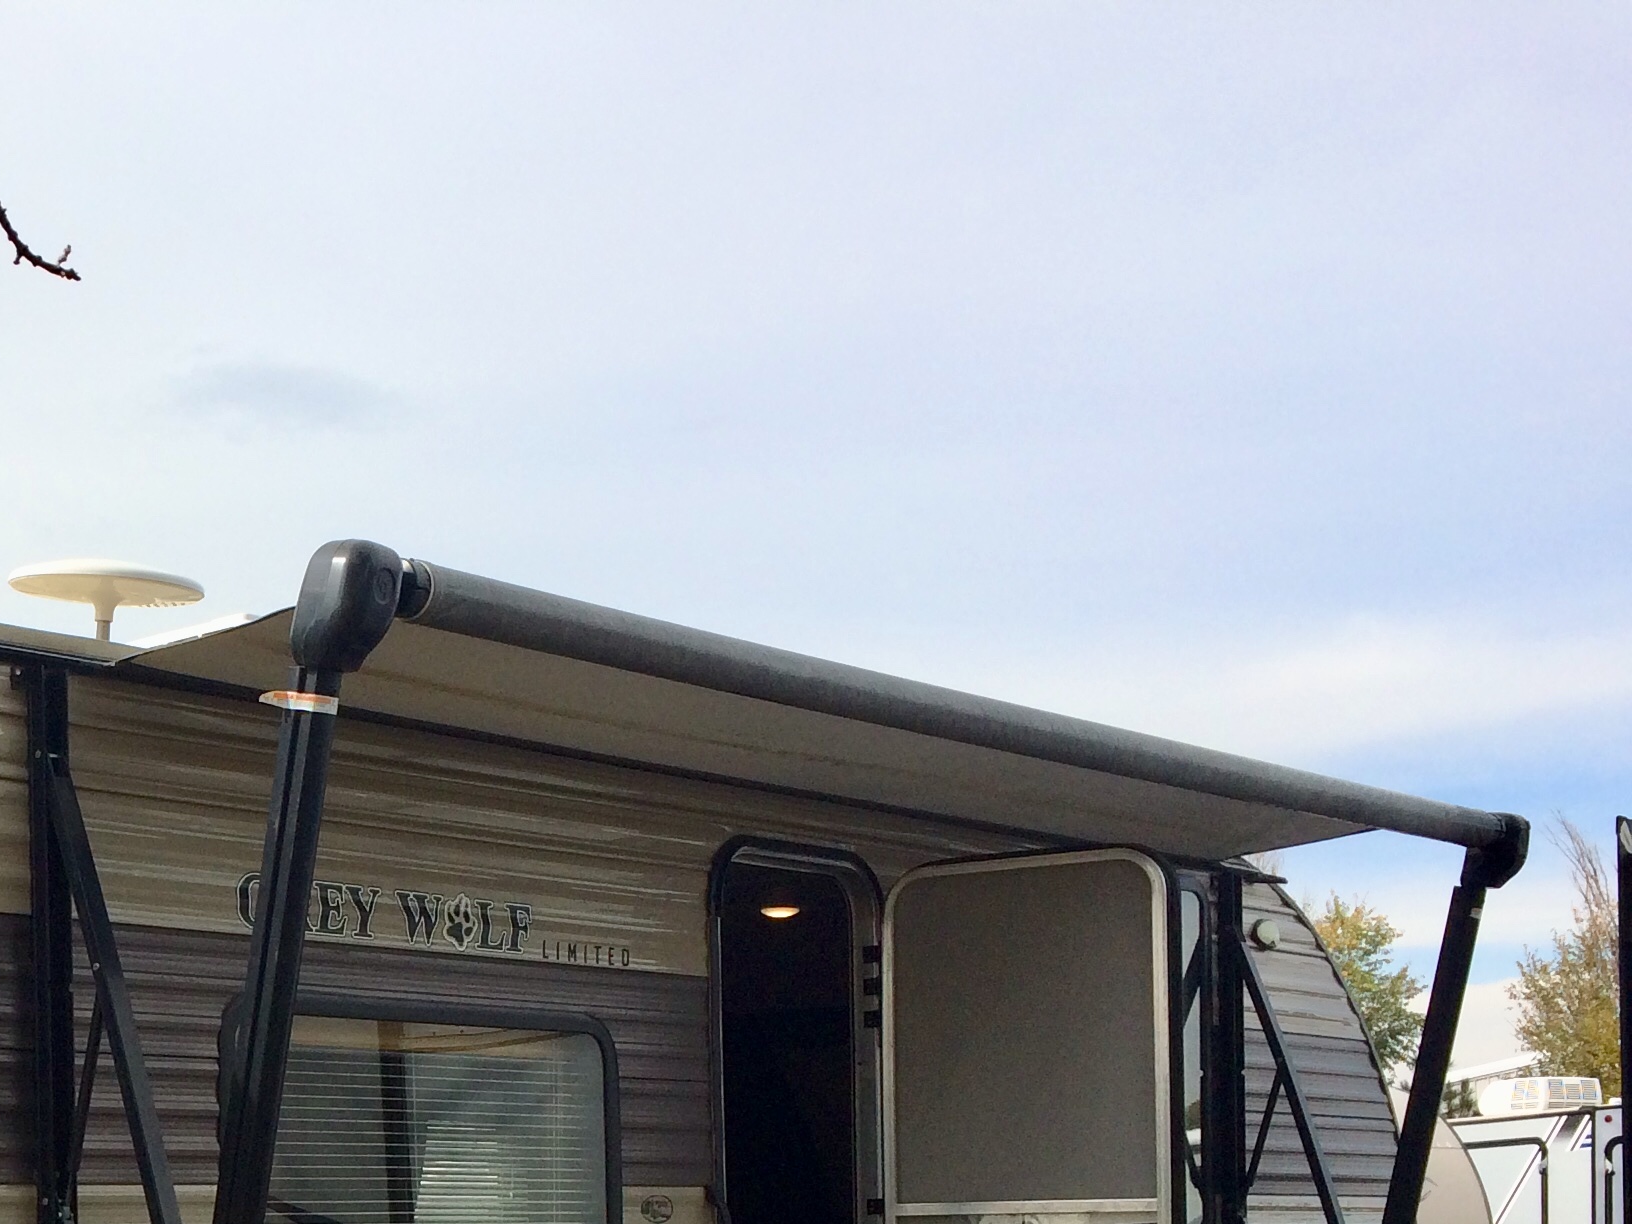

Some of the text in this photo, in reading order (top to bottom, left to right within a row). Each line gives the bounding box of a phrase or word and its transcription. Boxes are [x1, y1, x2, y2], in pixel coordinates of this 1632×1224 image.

[237, 872, 631, 967] EY WOLF LIMITED
